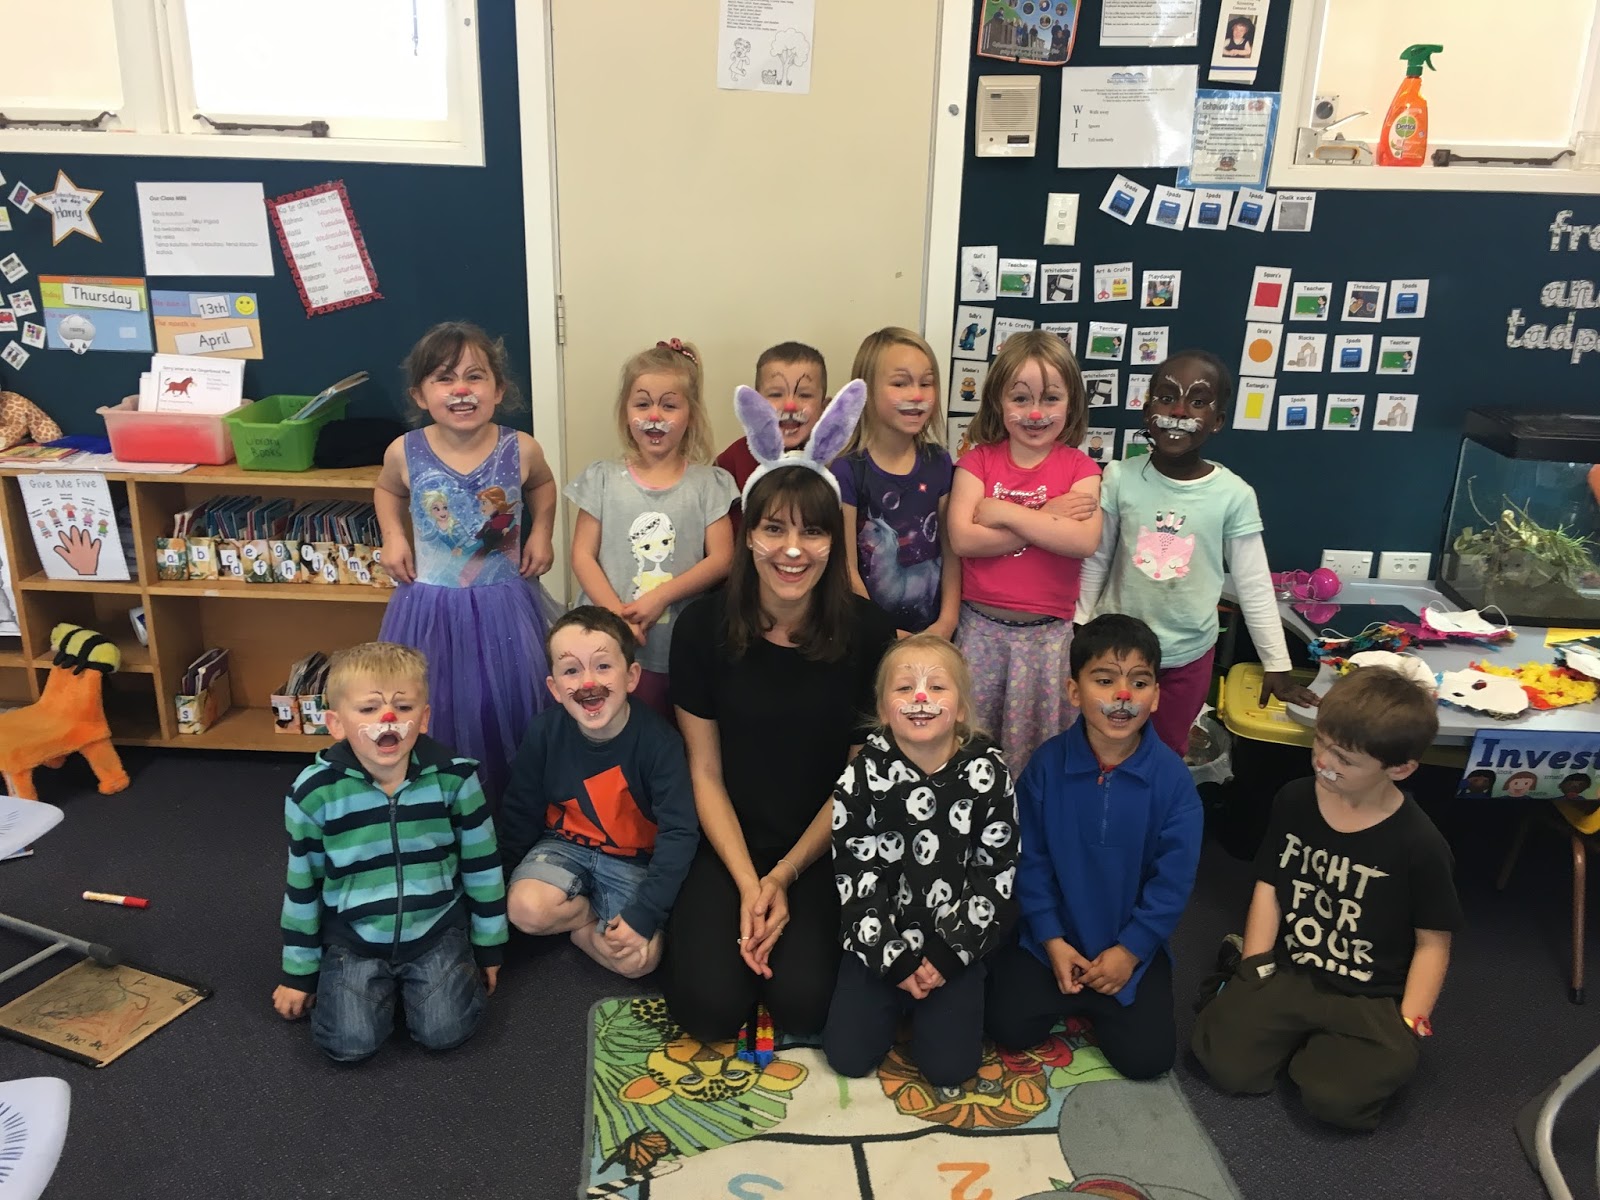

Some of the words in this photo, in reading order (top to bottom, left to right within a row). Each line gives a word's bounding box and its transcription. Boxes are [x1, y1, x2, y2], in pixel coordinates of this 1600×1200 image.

[1073, 104, 1084, 114] W
[1070, 132, 1078, 142] T
[54, 206, 82, 222] Harry
[72, 286, 132, 310] Thursday
[1540, 279, 1600, 310] an
[200, 302, 228, 314] 13th
[199, 332, 230, 350] April
[1506, 308, 1600, 365] tadp
[29, 479, 53, 489] Give
[56, 480, 72, 490] Me
[76, 478, 97, 488] Five
[196, 548, 205, 560] b
[245, 548, 253, 557] e
[275, 545, 283, 558] g
[167, 554, 177, 564] a
[226, 554, 233, 564] c
[233, 564, 242, 574] d
[256, 562, 264, 574] f
[285, 563, 294, 576] h
[349, 561, 360, 570] m
[327, 566, 334, 578] k
[360, 571, 368, 580] n
[283, 708, 289, 718] t
[304, 703, 311, 711] u
[182, 710, 189, 719] s
[315, 714, 322, 722] v
[1279, 833, 1390, 899] FIGHT
[1292, 879, 1362, 933] FOR
